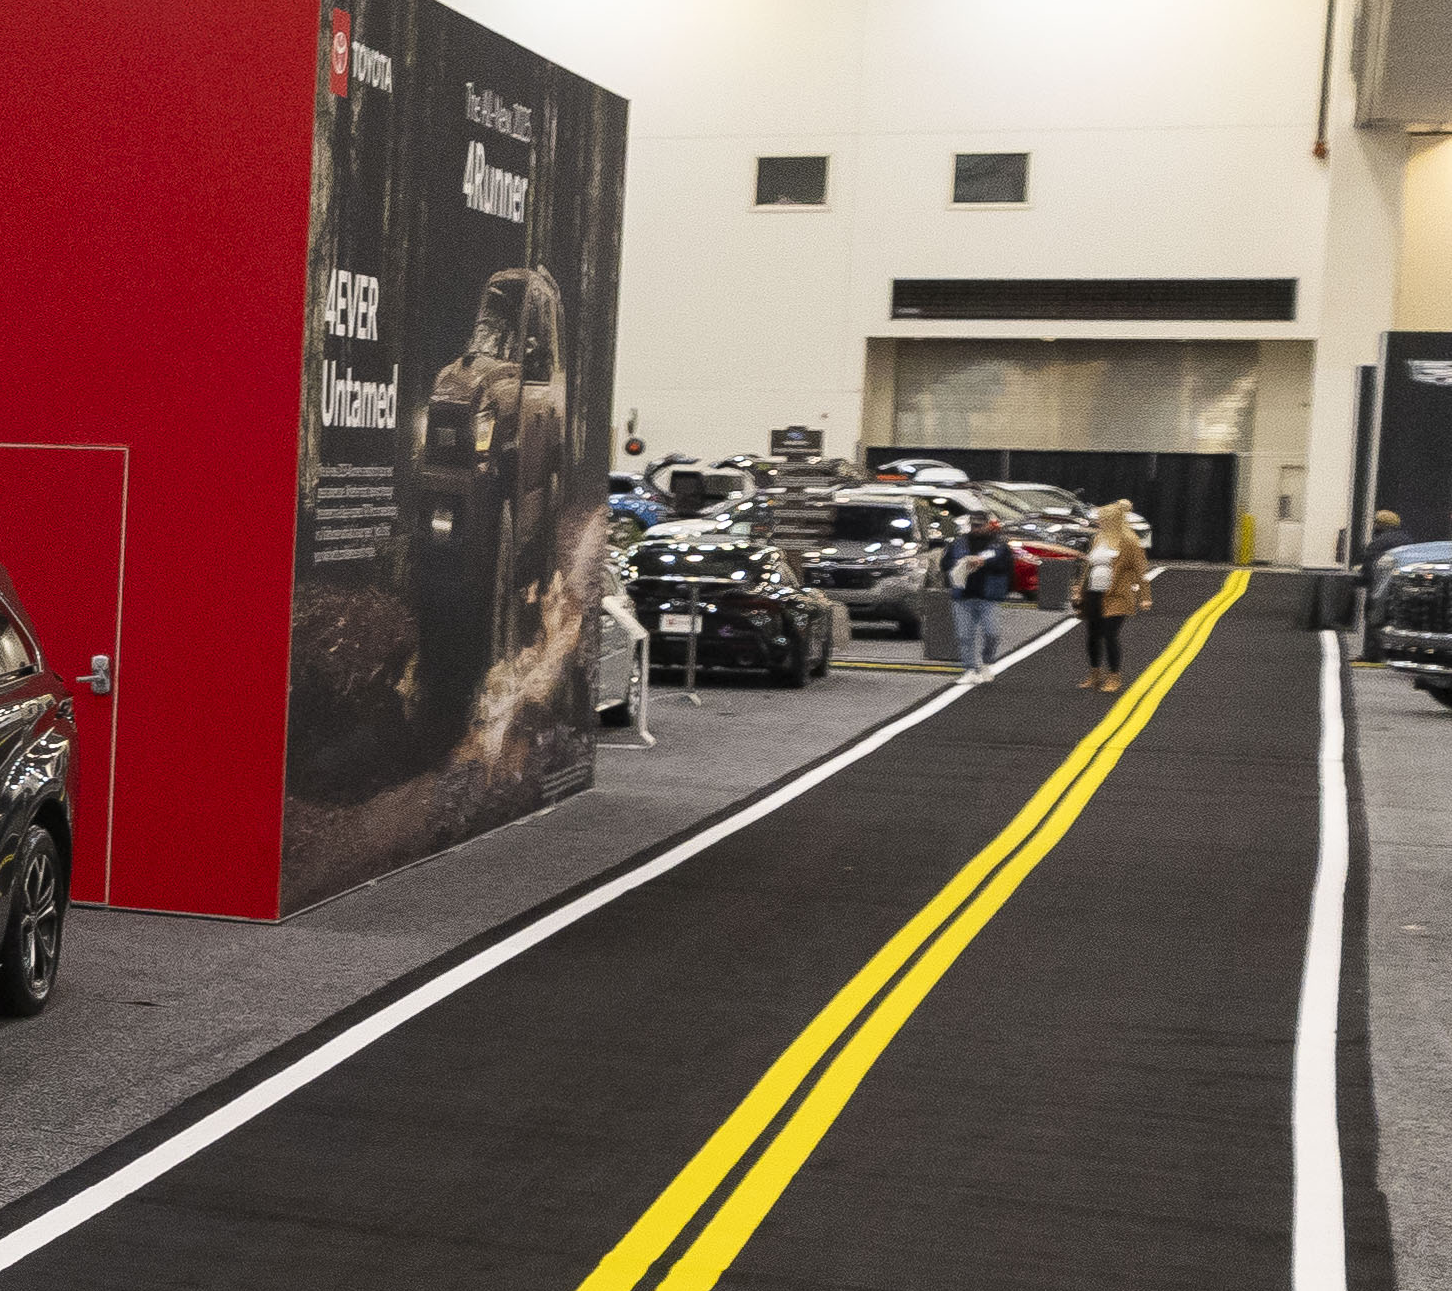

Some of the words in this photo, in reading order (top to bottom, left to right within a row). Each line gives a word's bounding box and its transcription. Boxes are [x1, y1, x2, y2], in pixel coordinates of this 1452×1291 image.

[351, 40, 393, 94] TOYOTA
[462, 140, 529, 224] 4Runner
[325, 268, 379, 342] 4EVER
[320, 359, 399, 429] Untamed
